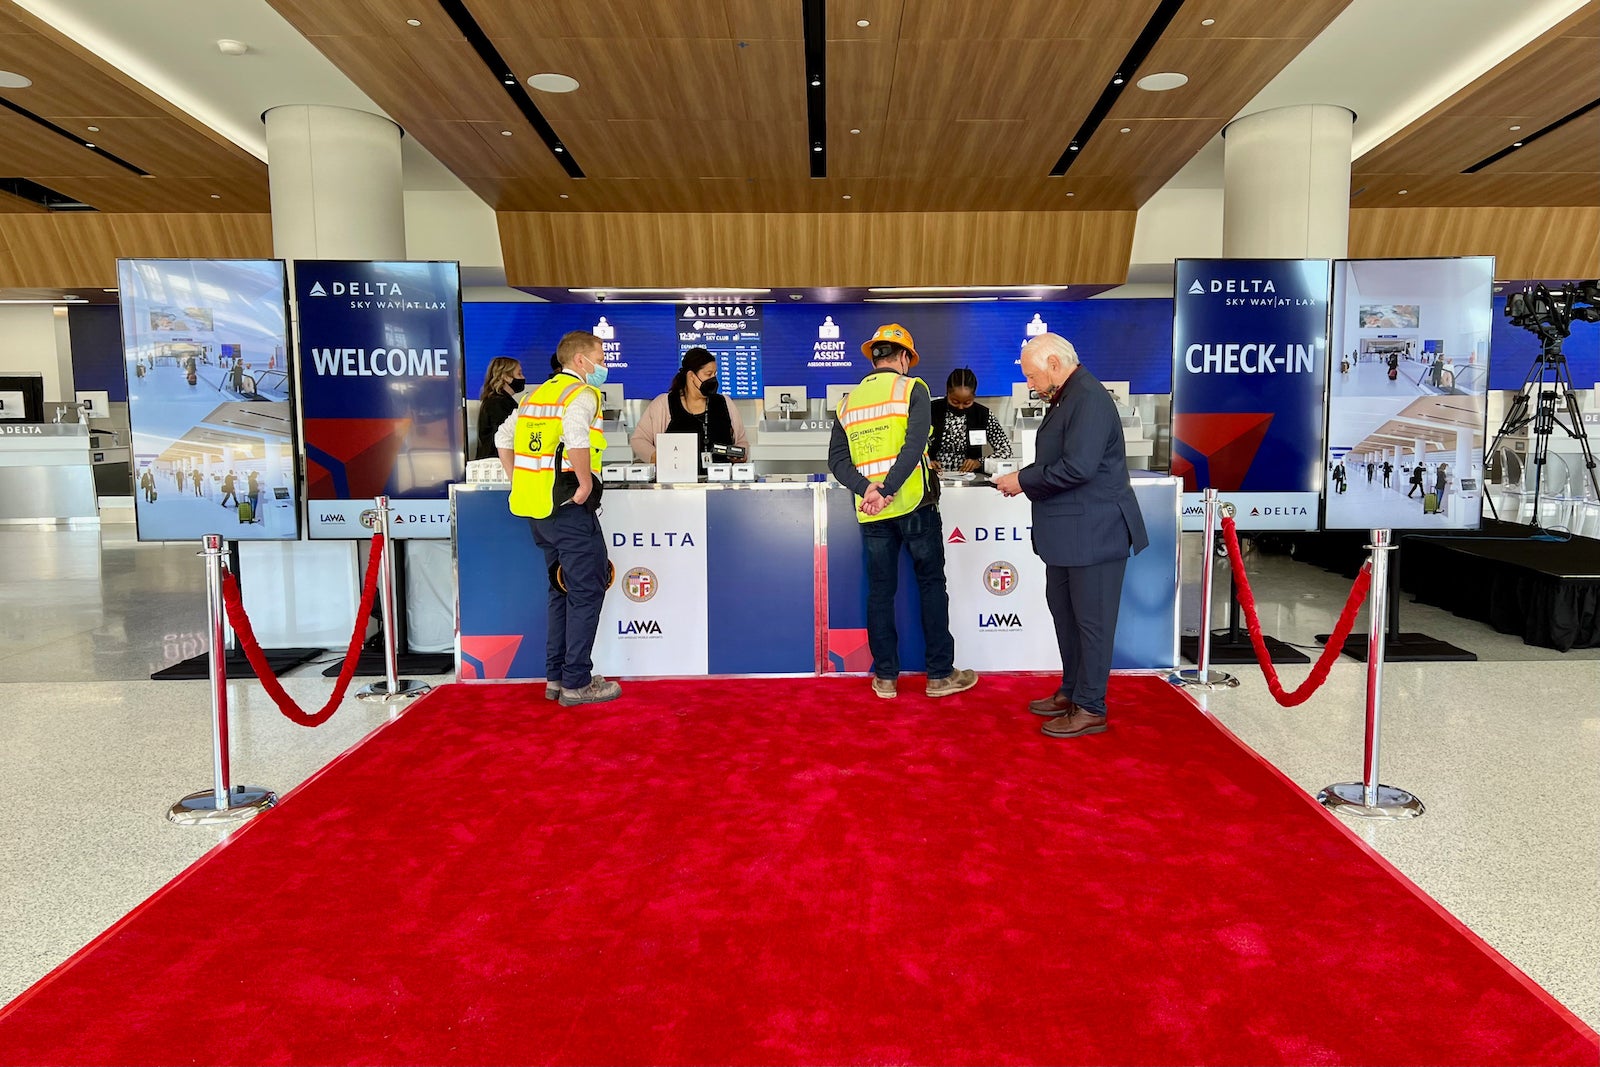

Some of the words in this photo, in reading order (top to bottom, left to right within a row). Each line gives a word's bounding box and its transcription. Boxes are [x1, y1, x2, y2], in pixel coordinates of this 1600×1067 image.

[333, 282, 402, 295] DELTA
[1211, 280, 1275, 293] DELTA
[425, 301, 446, 309] LAX
[698, 306, 742, 316] DELTA
[602, 342, 620, 351] ENT
[814, 342, 845, 350] AGENT
[312, 348, 450, 376] WELCOME
[814, 351, 845, 360] ASSIST
[1185, 344, 1314, 374] CHECK-IN
[1264, 507, 1307, 515] DELTA
[320, 514, 346, 522] LAWA
[613, 532, 695, 546] DELTA
[975, 527, 1032, 541] DEL
[618, 620, 662, 634] LAWA
[979, 614, 1022, 628] LAWA
